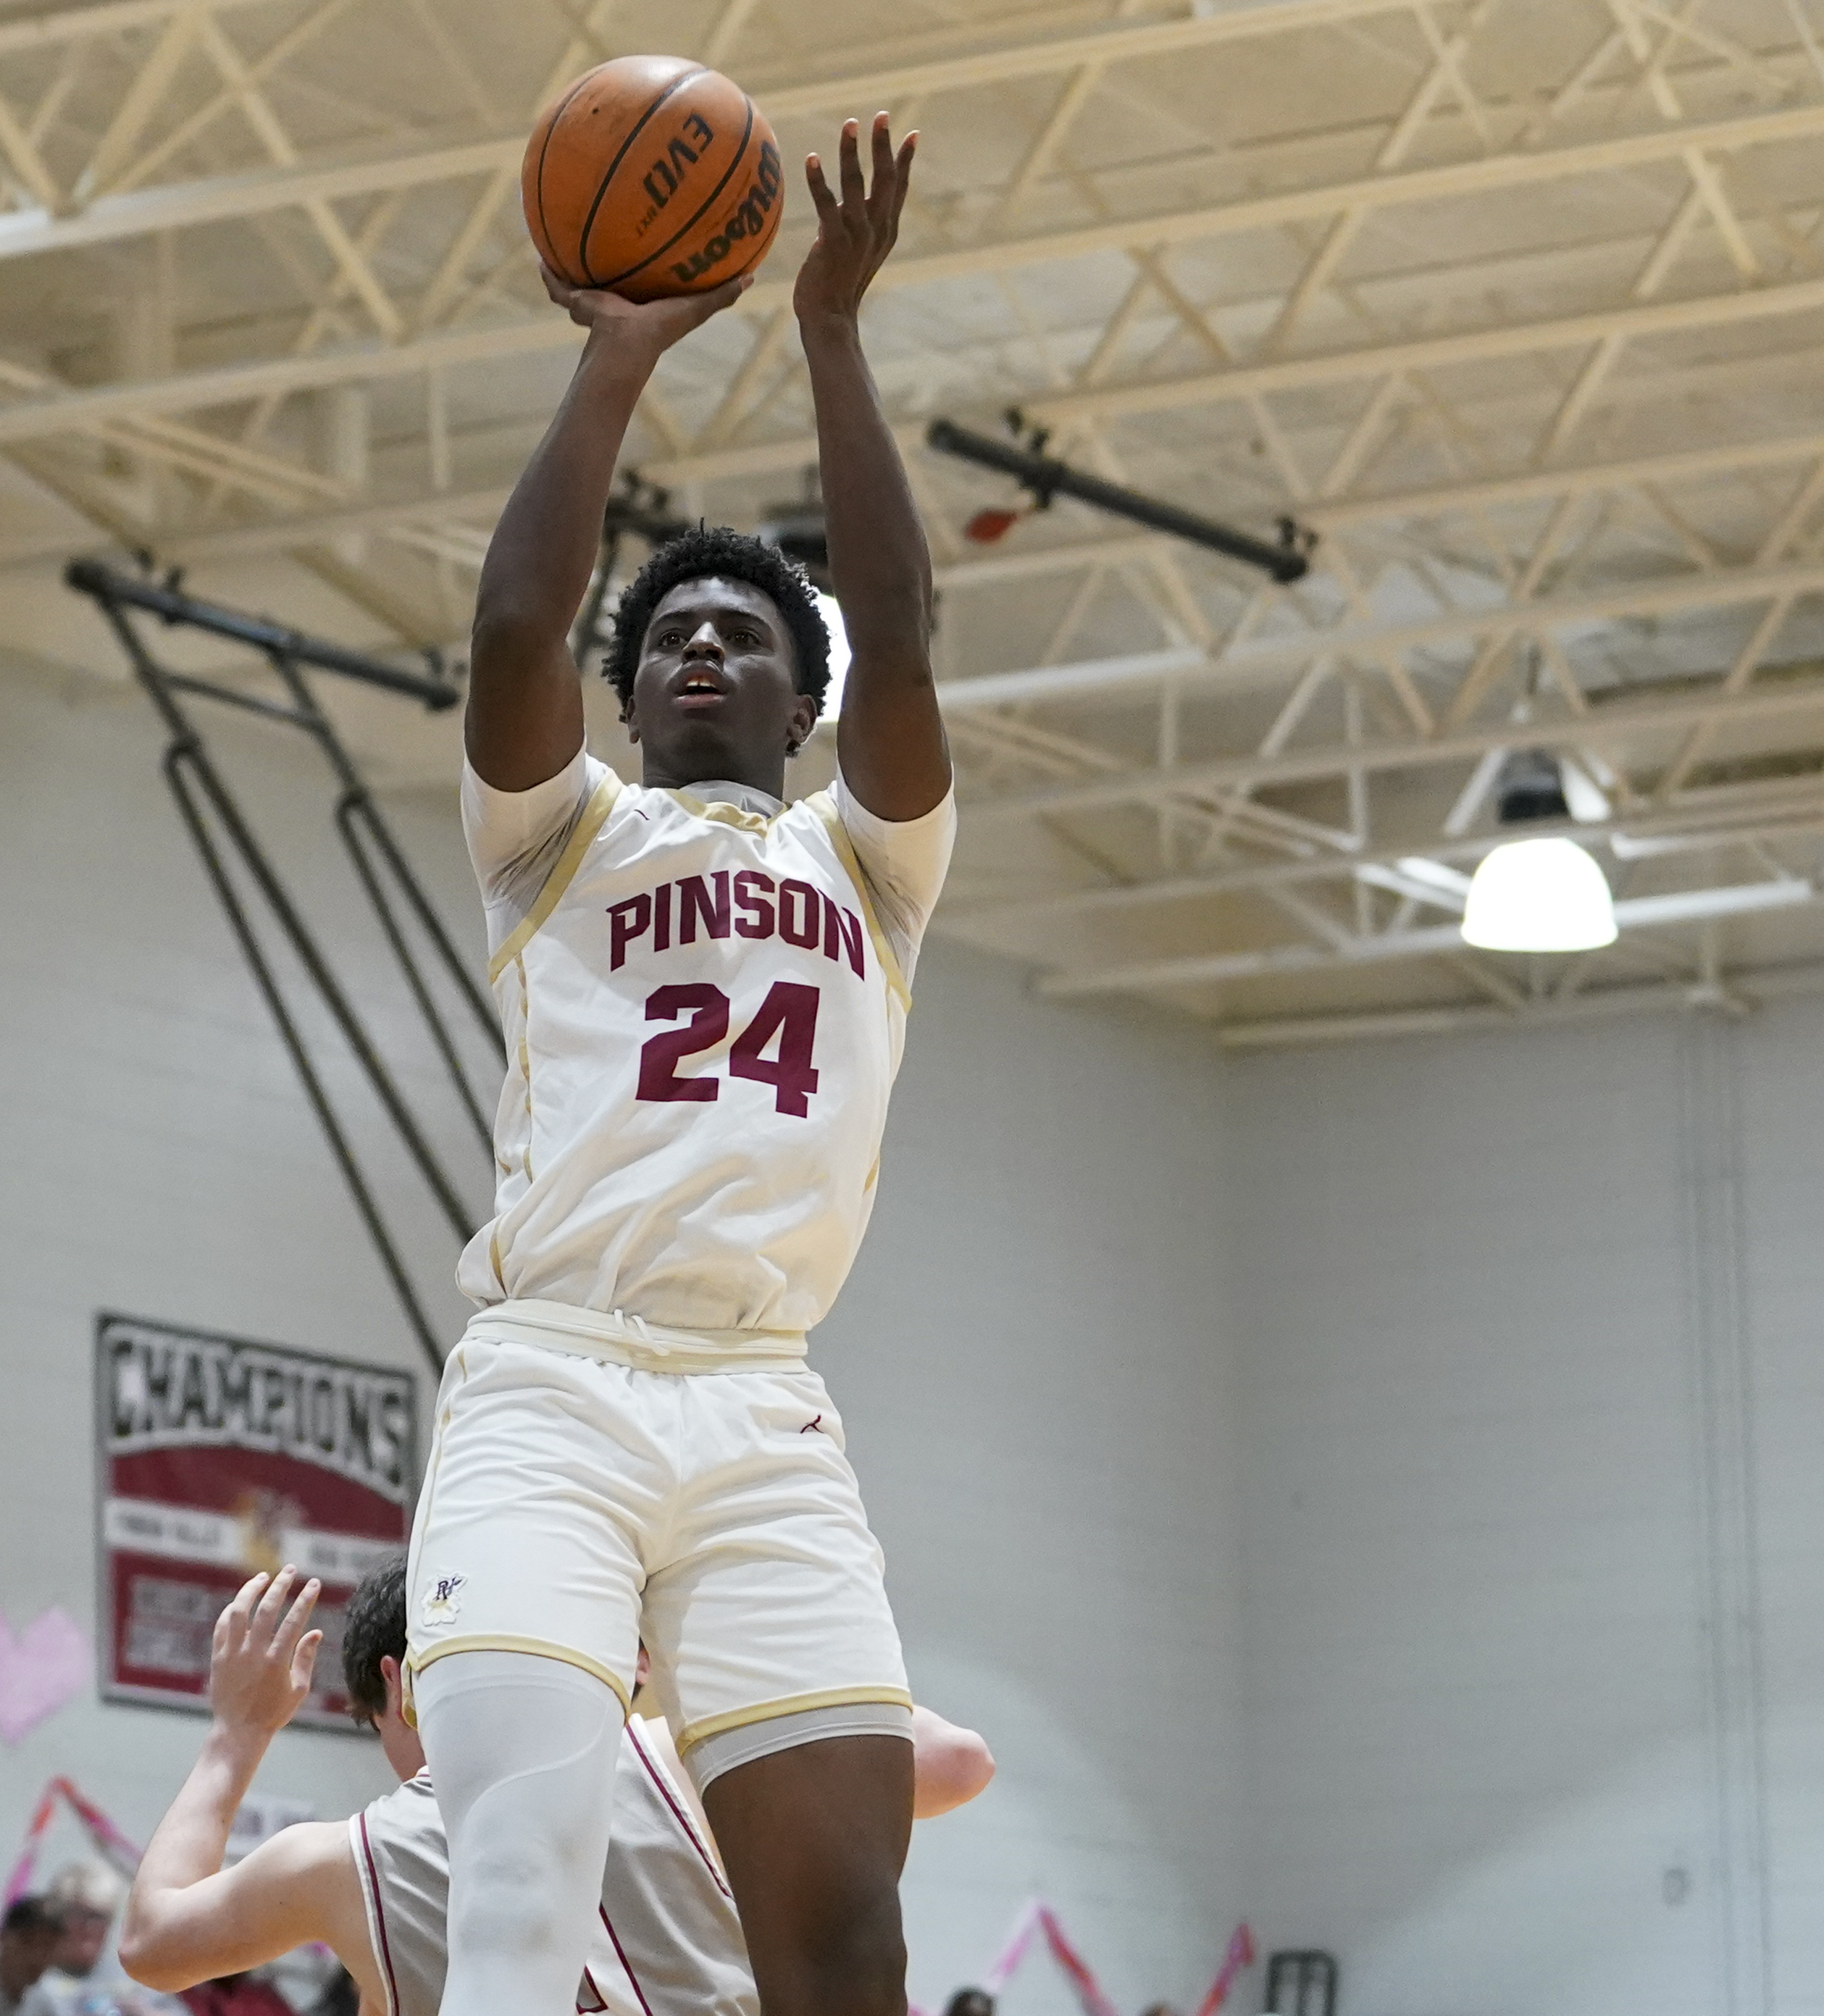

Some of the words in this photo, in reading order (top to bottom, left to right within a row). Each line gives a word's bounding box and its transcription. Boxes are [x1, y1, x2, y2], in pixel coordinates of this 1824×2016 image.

[643, 112, 714, 209] EVO
[672, 141, 781, 282] Wilson
[606, 870, 865, 982] PINSON
[635, 981, 820, 1118] 24
[109, 1336, 407, 1491] CHAMPIONS
